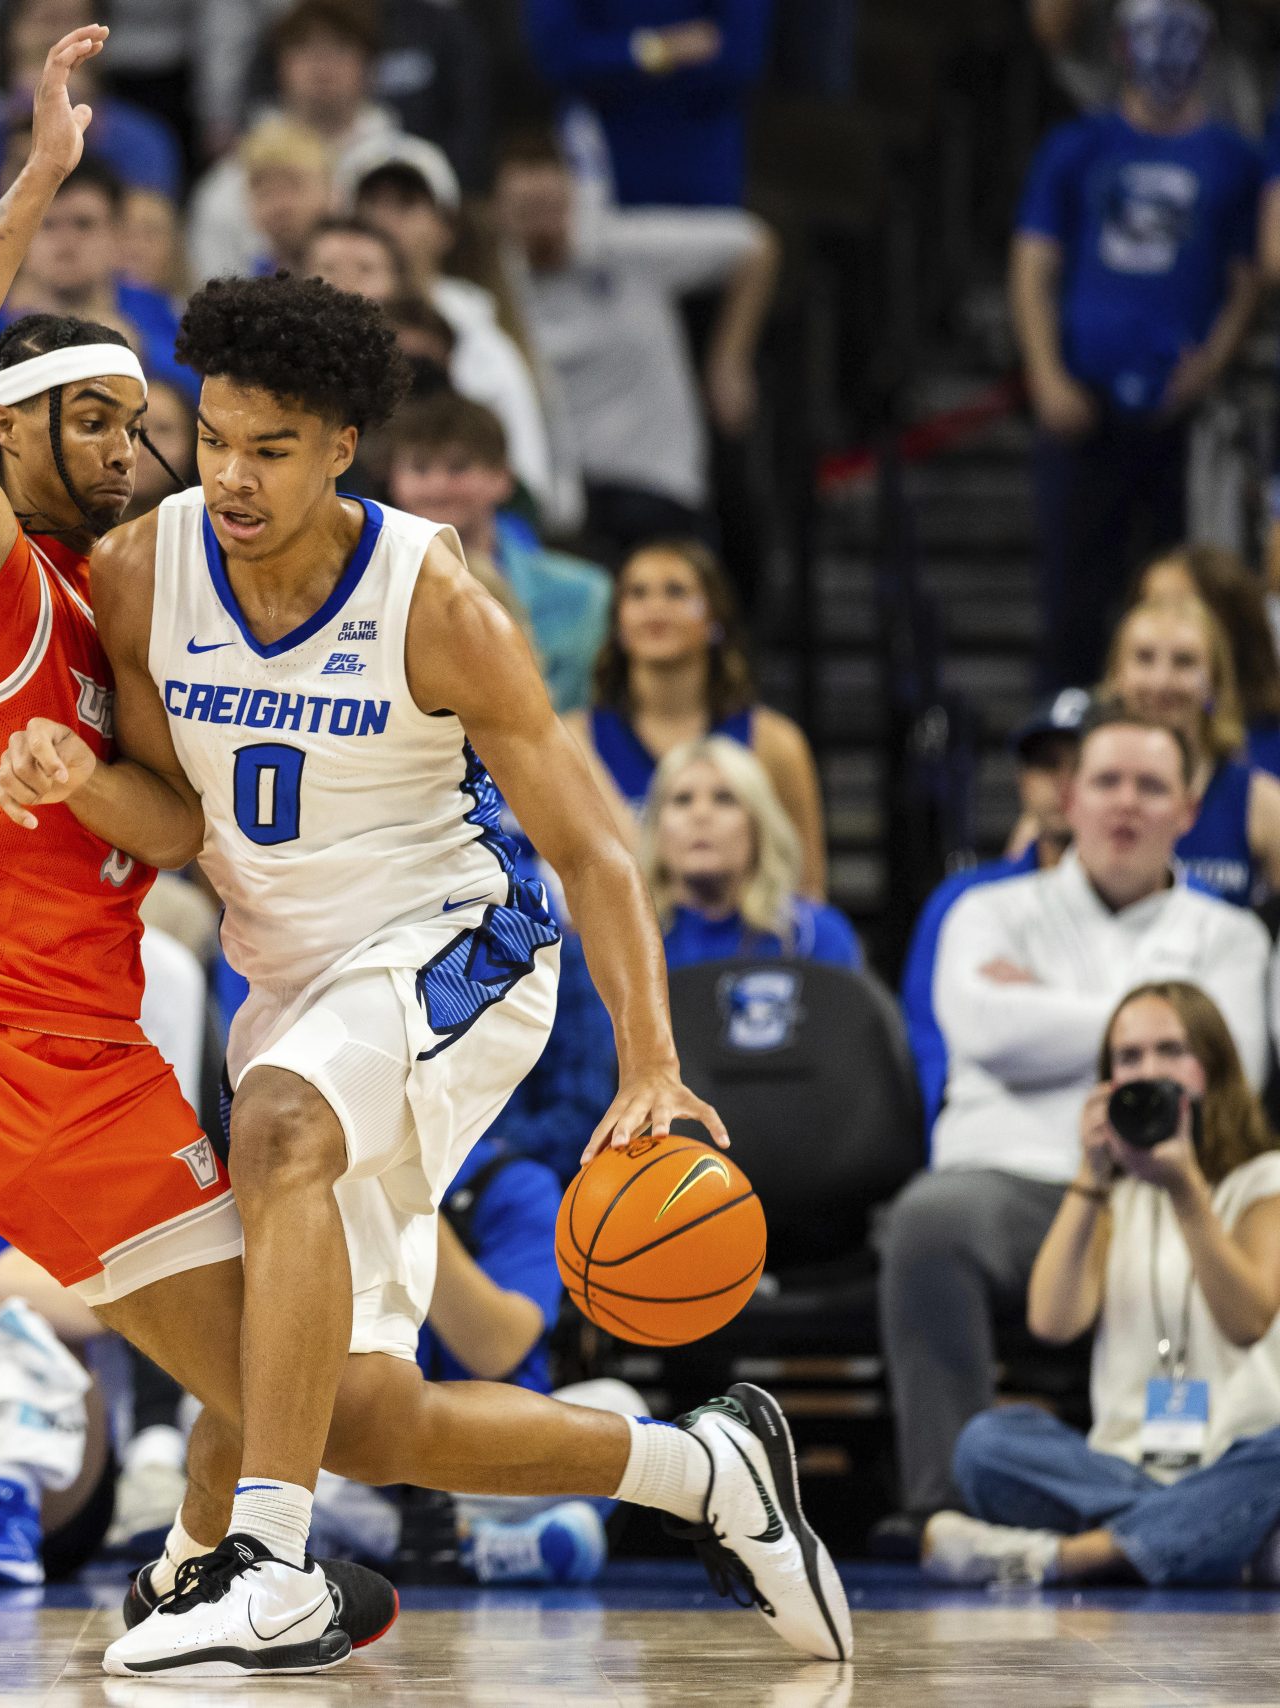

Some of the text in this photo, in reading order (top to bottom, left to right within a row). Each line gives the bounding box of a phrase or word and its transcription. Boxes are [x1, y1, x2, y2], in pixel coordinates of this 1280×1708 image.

[342, 620, 377, 631] BE THE
[337, 630, 378, 641] CHANGE
[328, 652, 360, 663] BIG
[323, 661, 367, 672] EAST
[164, 679, 391, 737] CREIGHTON
[232, 742, 307, 846] 0
